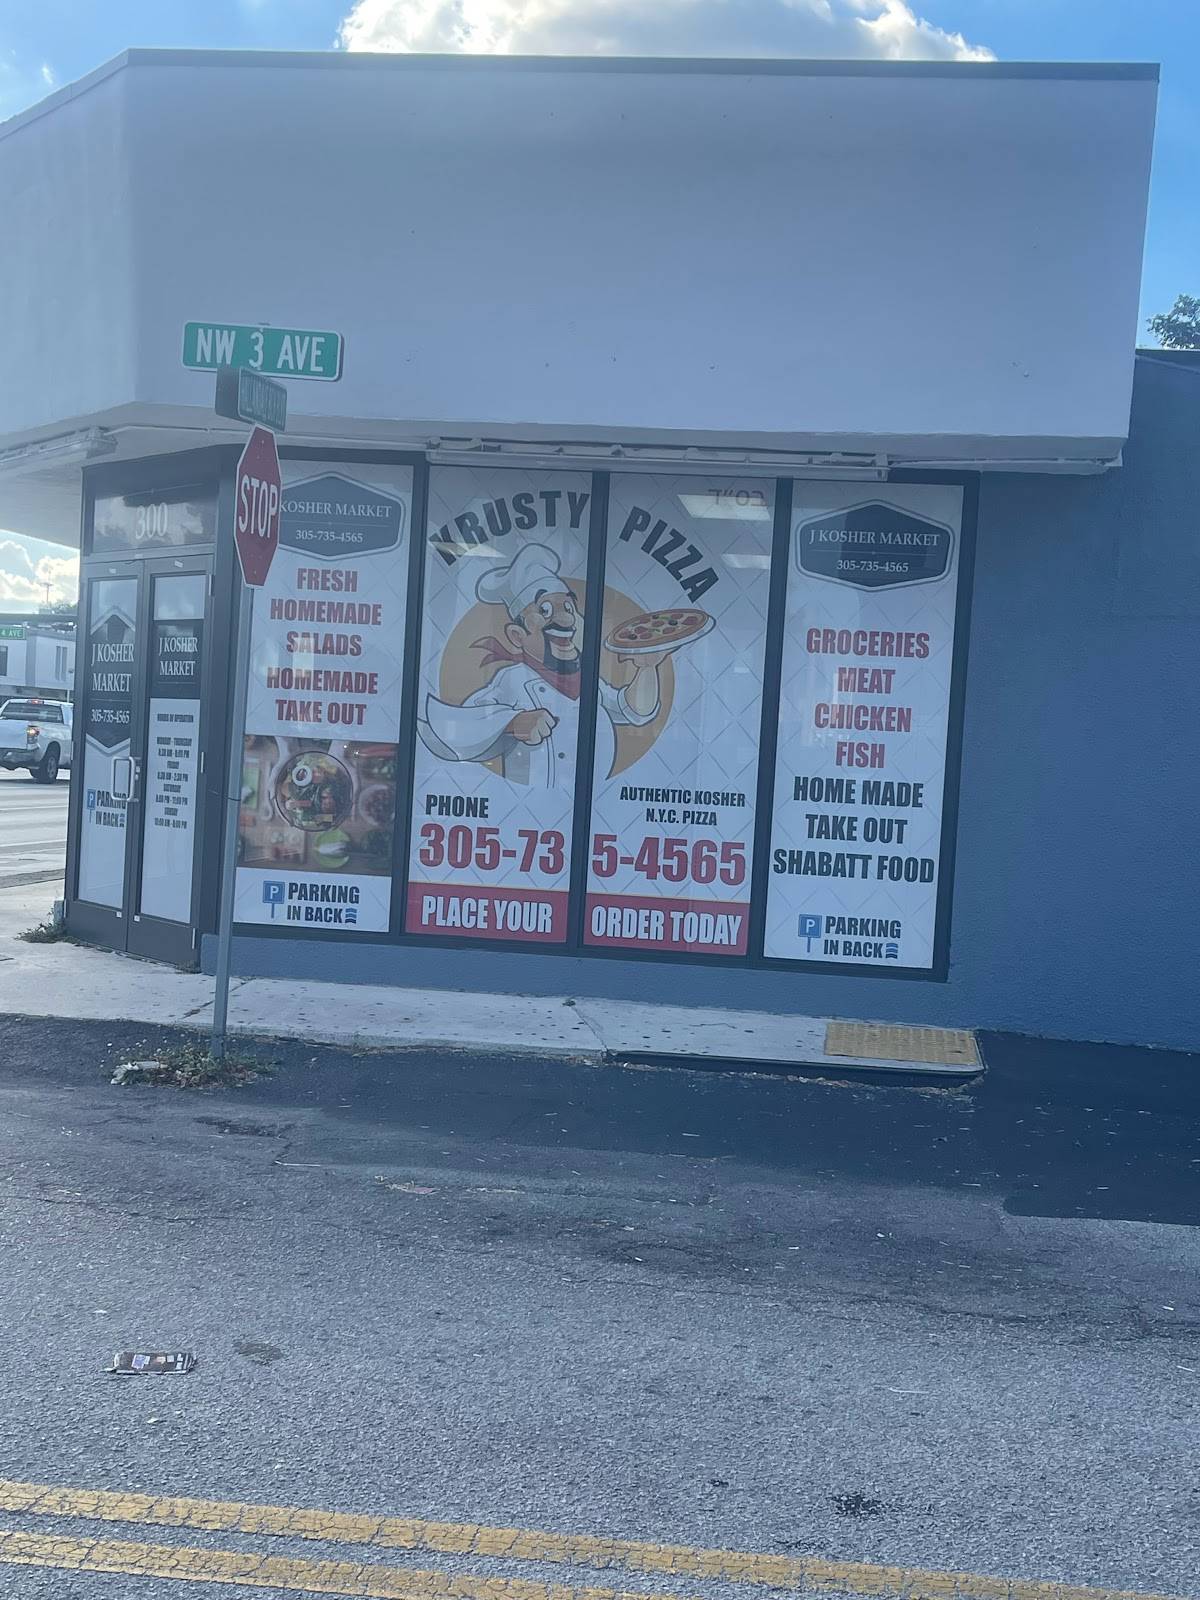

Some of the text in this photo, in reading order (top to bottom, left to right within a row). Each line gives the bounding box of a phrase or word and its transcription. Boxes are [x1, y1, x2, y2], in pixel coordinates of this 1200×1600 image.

[196, 328, 325, 372] NW 3 AVE
[238, 474, 278, 538] STOP
[335, 503, 392, 518] MARKET
[135, 502, 168, 540] 300
[296, 530, 364, 543] 305-735-4565
[429, 490, 720, 604] KRUSTY PIZZA
[808, 529, 940, 547] J KOSHER MARKET
[837, 559, 909, 573] 305-735-4565
[297, 568, 358, 592] FRESH
[270, 598, 382, 626] HOMEMADE
[91, 643, 135, 666] J KOSHER
[159, 637, 198, 656] J KOSHER
[286, 631, 362, 657] SALADS
[806, 627, 930, 659] GROCERIES
[160, 660, 196, 676] MARKET
[266, 667, 379, 694] HOMEMADE
[837, 667, 896, 694] MEAT
[92, 673, 131, 692] MARKET
[275, 699, 367, 726] TAKE OUT
[814, 702, 912, 733] CHICKEN
[835, 741, 886, 769] FISH
[619, 786, 746, 807] AUTHENTIC KOSHER
[793, 776, 924, 808] HOME MADE
[425, 794, 489, 819] PHONE
[646, 808, 718, 826] N.Y.C. PIZZA
[805, 813, 908, 844] TAKE OUT
[419, 823, 746, 886] 305-73 5-4565
[773, 849, 935, 883] SHABATT FOOD
[288, 882, 360, 904] PARKING
[287, 905, 343, 924] IN BACK
[421, 895, 743, 946] PLACE YOUR ORDER TODAY
[825, 915, 902, 938] PARKING
[823, 939, 883, 958] IN BACK
